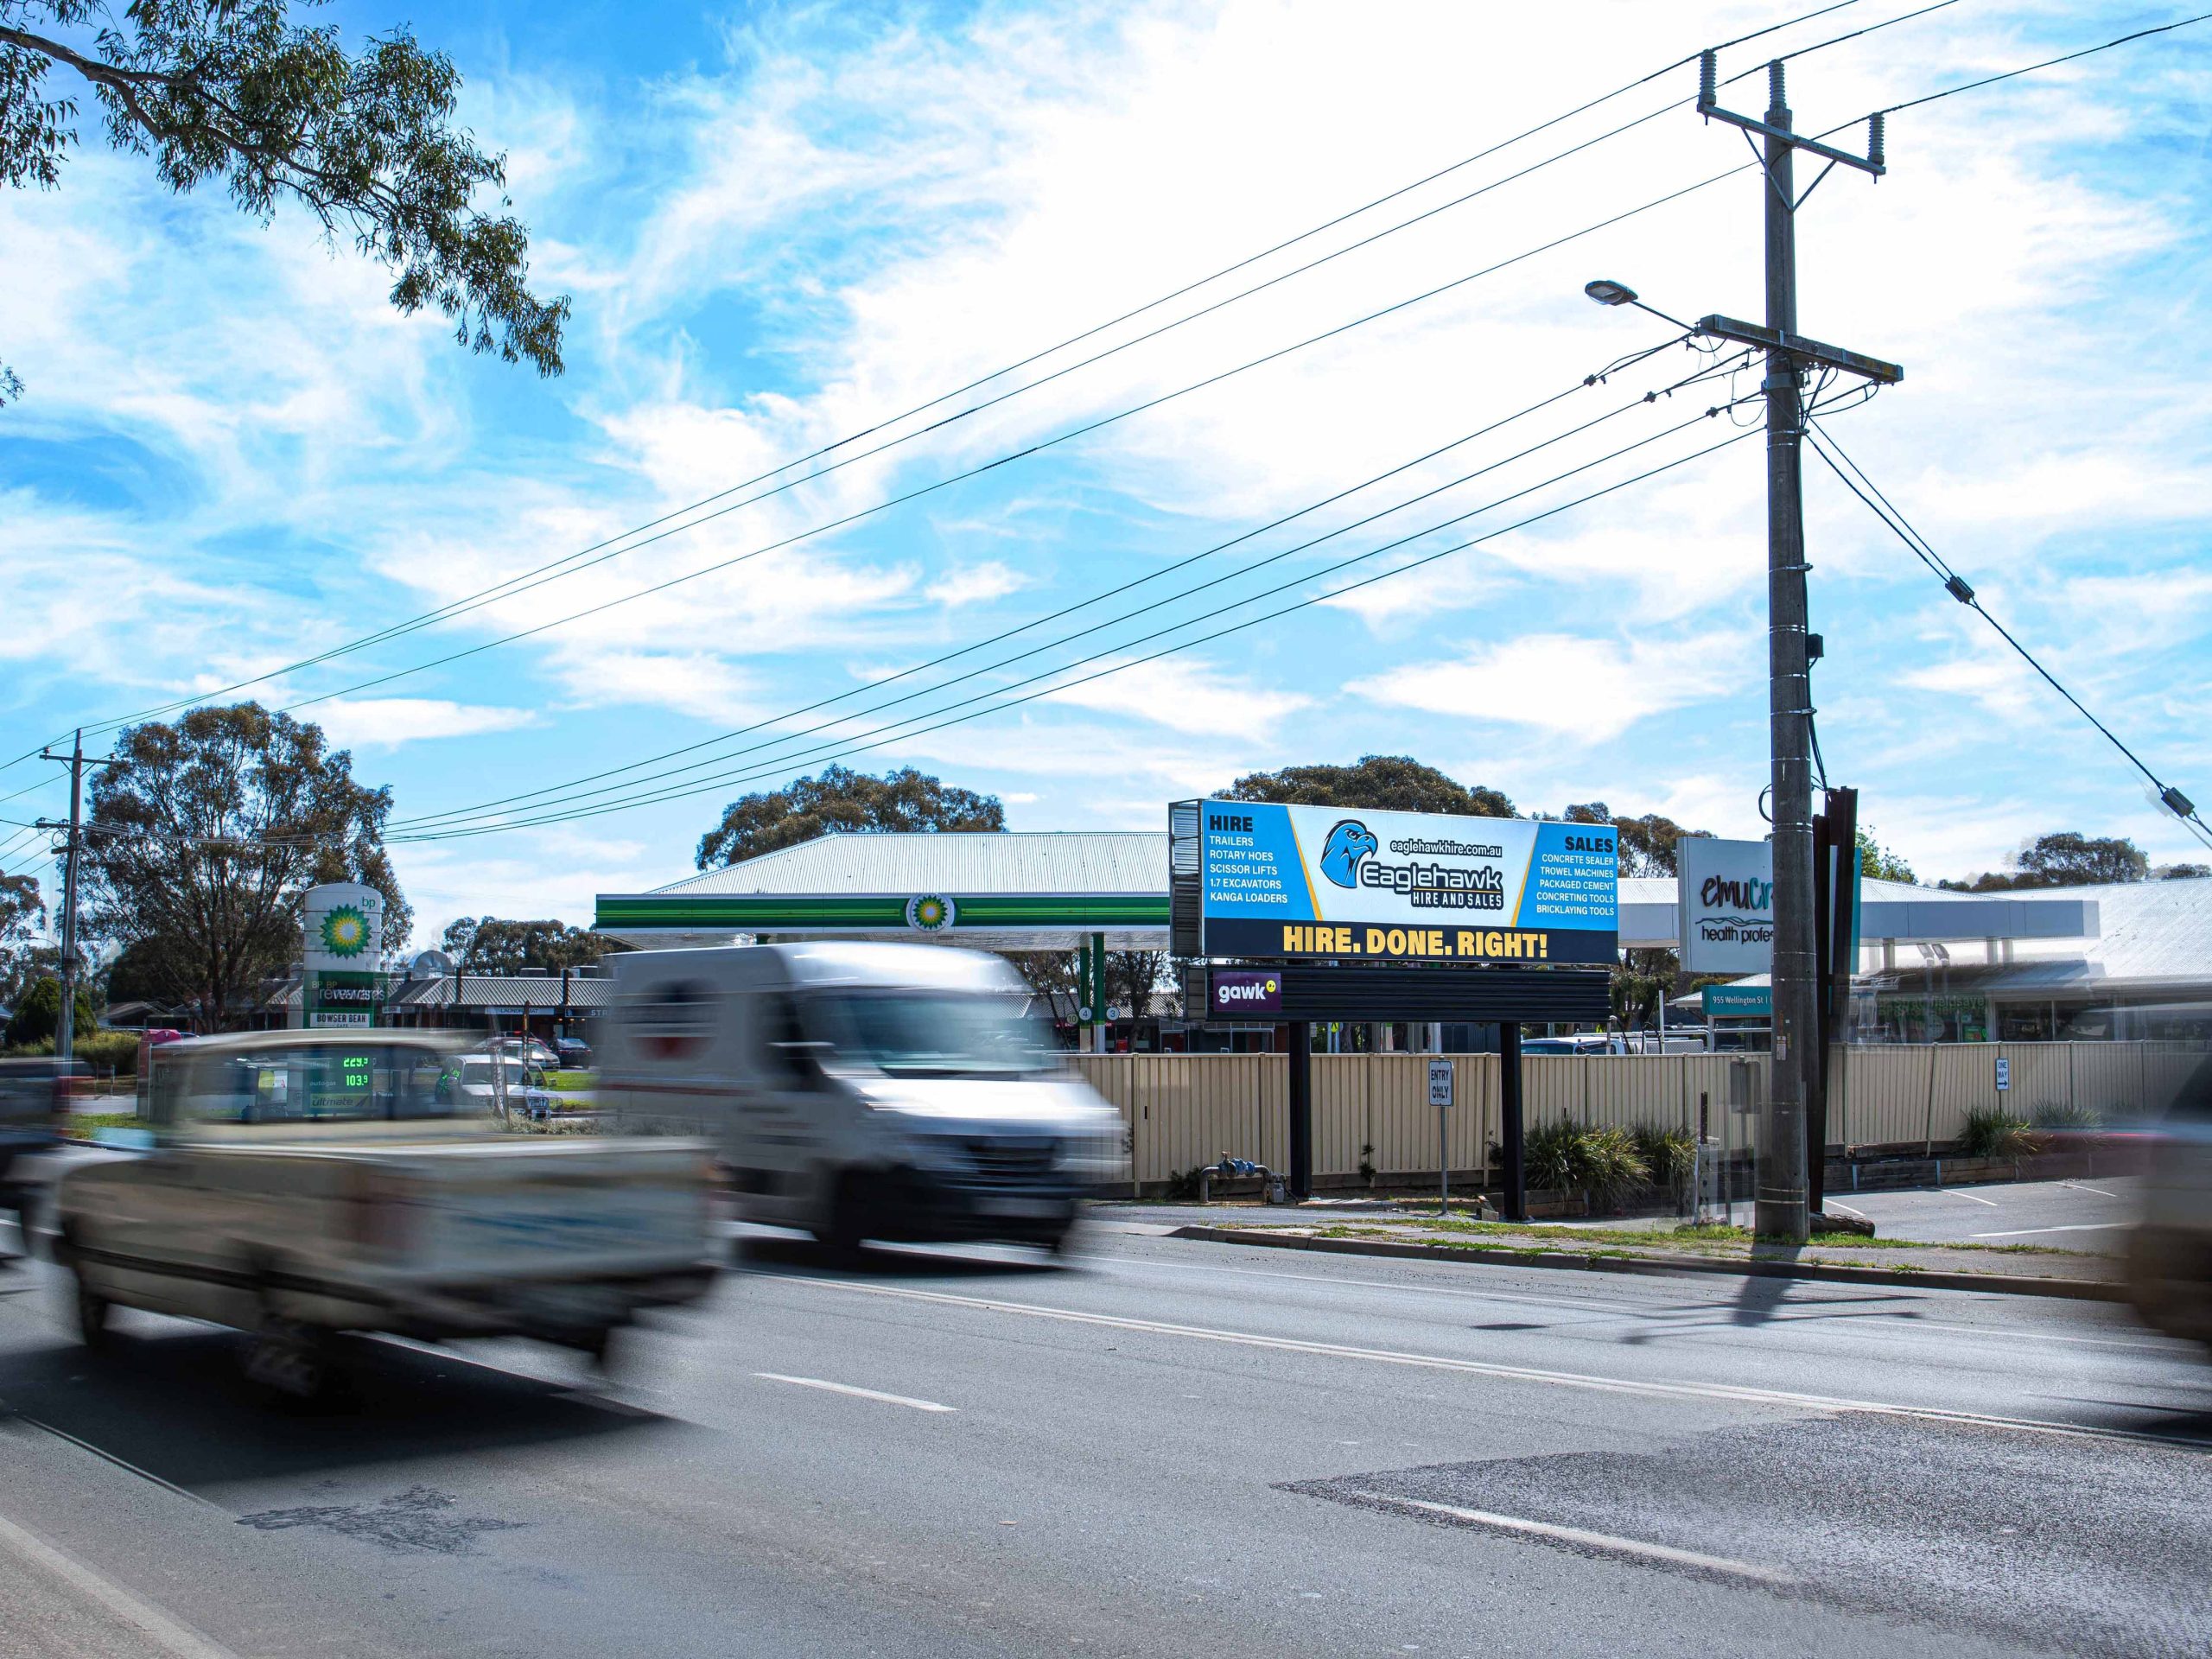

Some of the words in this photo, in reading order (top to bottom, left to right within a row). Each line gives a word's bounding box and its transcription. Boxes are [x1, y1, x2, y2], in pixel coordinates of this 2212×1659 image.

[1210, 815, 1253, 832] HIRE
[1210, 836, 1254, 847] TRAILERS
[1565, 836, 1613, 853] SALES
[1390, 839, 1502, 857] eaglehawkhire.com.au
[1210, 849, 1246, 860] ROTARY
[1249, 851, 1274, 861] HOES
[1541, 854, 1584, 864] CONCRETE
[1586, 856, 1614, 866] SEALER
[1210, 864, 1250, 874] SCISSOR
[1252, 865, 1277, 875] LIFTS
[1540, 866, 1573, 876] TROWEL
[1574, 868, 1614, 878] MACHINES
[1211, 878, 1221, 887] 1.7
[1223, 878, 1281, 889] EXCAVATORS
[1362, 862, 1502, 893] Eaglehawk
[1540, 879, 1581, 889] PACKAGED
[1583, 881, 1614, 891] CEMENT
[362, 896, 376, 909] bp
[1211, 892, 1243, 902] KANGA
[1246, 893, 1288, 904] LOADERS
[1413, 892, 1439, 906] HIRE
[1442, 893, 1465, 906] AND
[1467, 893, 1502, 907] SALES
[1536, 892, 1587, 902] CONCRETING
[1589, 893, 1614, 903] TOOLS
[1536, 905, 1588, 915] BRICKLAYING
[1589, 906, 1614, 916] TOOLS
[1702, 925, 1738, 942] health
[1283, 925, 1360, 953] HIRE.
[1366, 928, 1452, 956] DONE.
[1458, 931, 1548, 957] RIGHT!
[1218, 982, 1267, 1003] gawk
[1713, 995, 1724, 1004] 955
[1725, 995, 1756, 1006] Wellington
[1757, 995, 1764, 1004] St
[317, 1014, 347, 1023] BOWSER
[348, 1014, 366, 1023] BEAN
[1109, 1009, 1116, 1018] 3
[346, 1074, 369, 1086] 103.9
[1431, 1069, 1449, 1081] ENTRY
[1432, 1085, 1449, 1098] ONLY
[312, 1097, 353, 1107] ultimate
